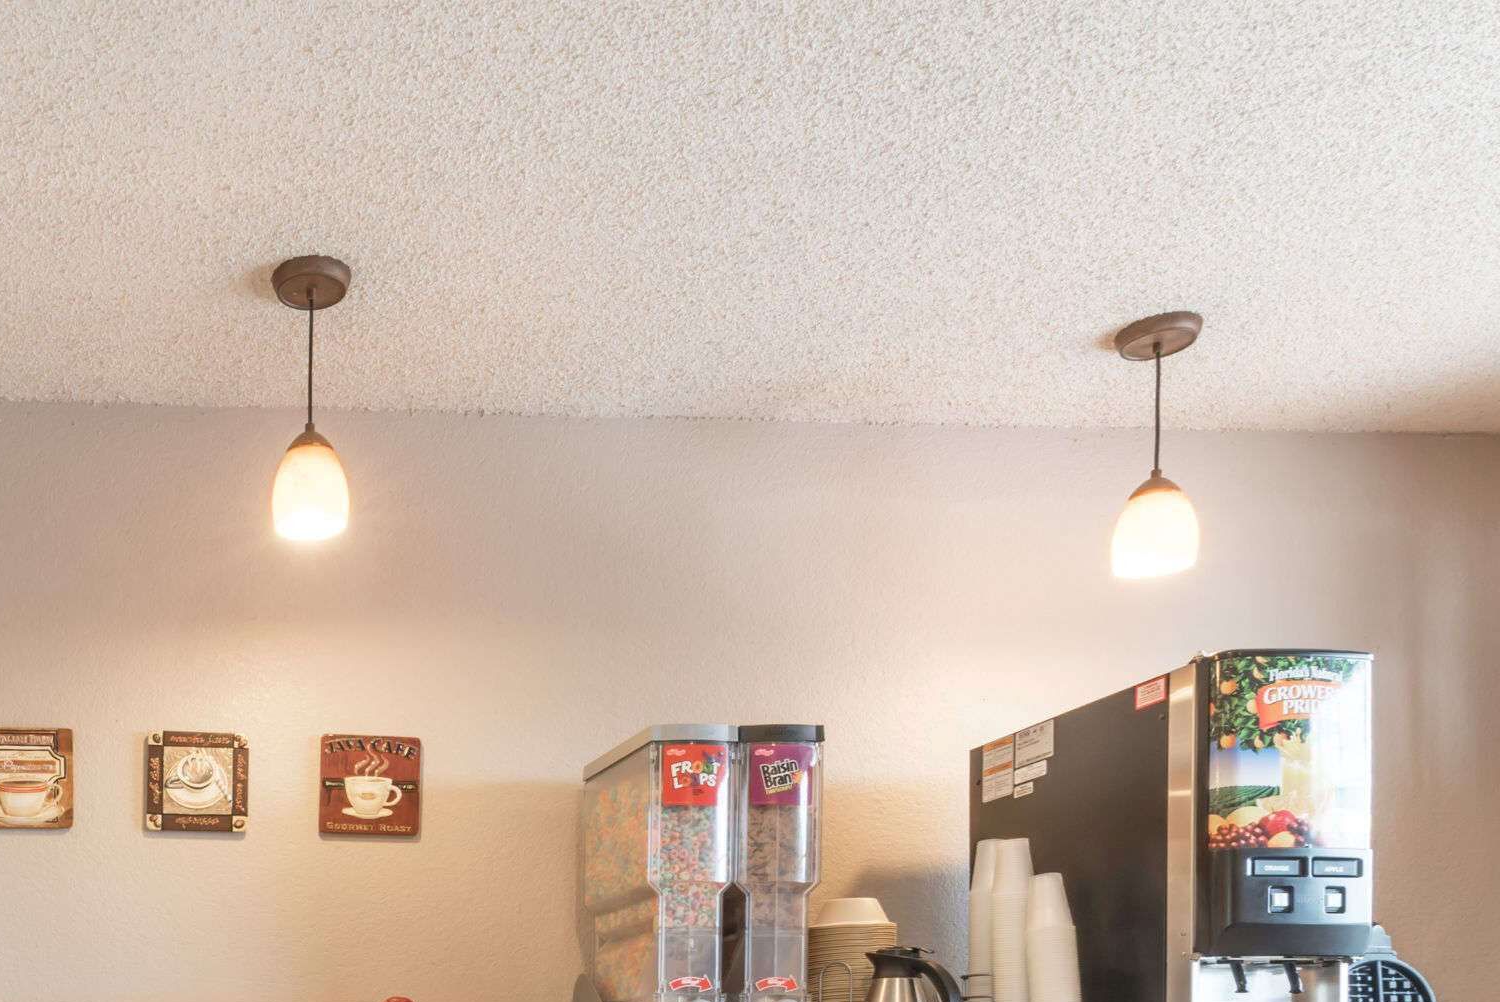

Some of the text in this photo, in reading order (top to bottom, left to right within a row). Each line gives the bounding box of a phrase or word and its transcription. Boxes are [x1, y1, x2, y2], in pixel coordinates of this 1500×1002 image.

[1263, 685, 1336, 704] GROWER
[670, 759, 721, 778] FROOT
[761, 759, 798, 777] Raisin
[673, 773, 717, 789] LOOPS
[764, 773, 793, 789] Bran
